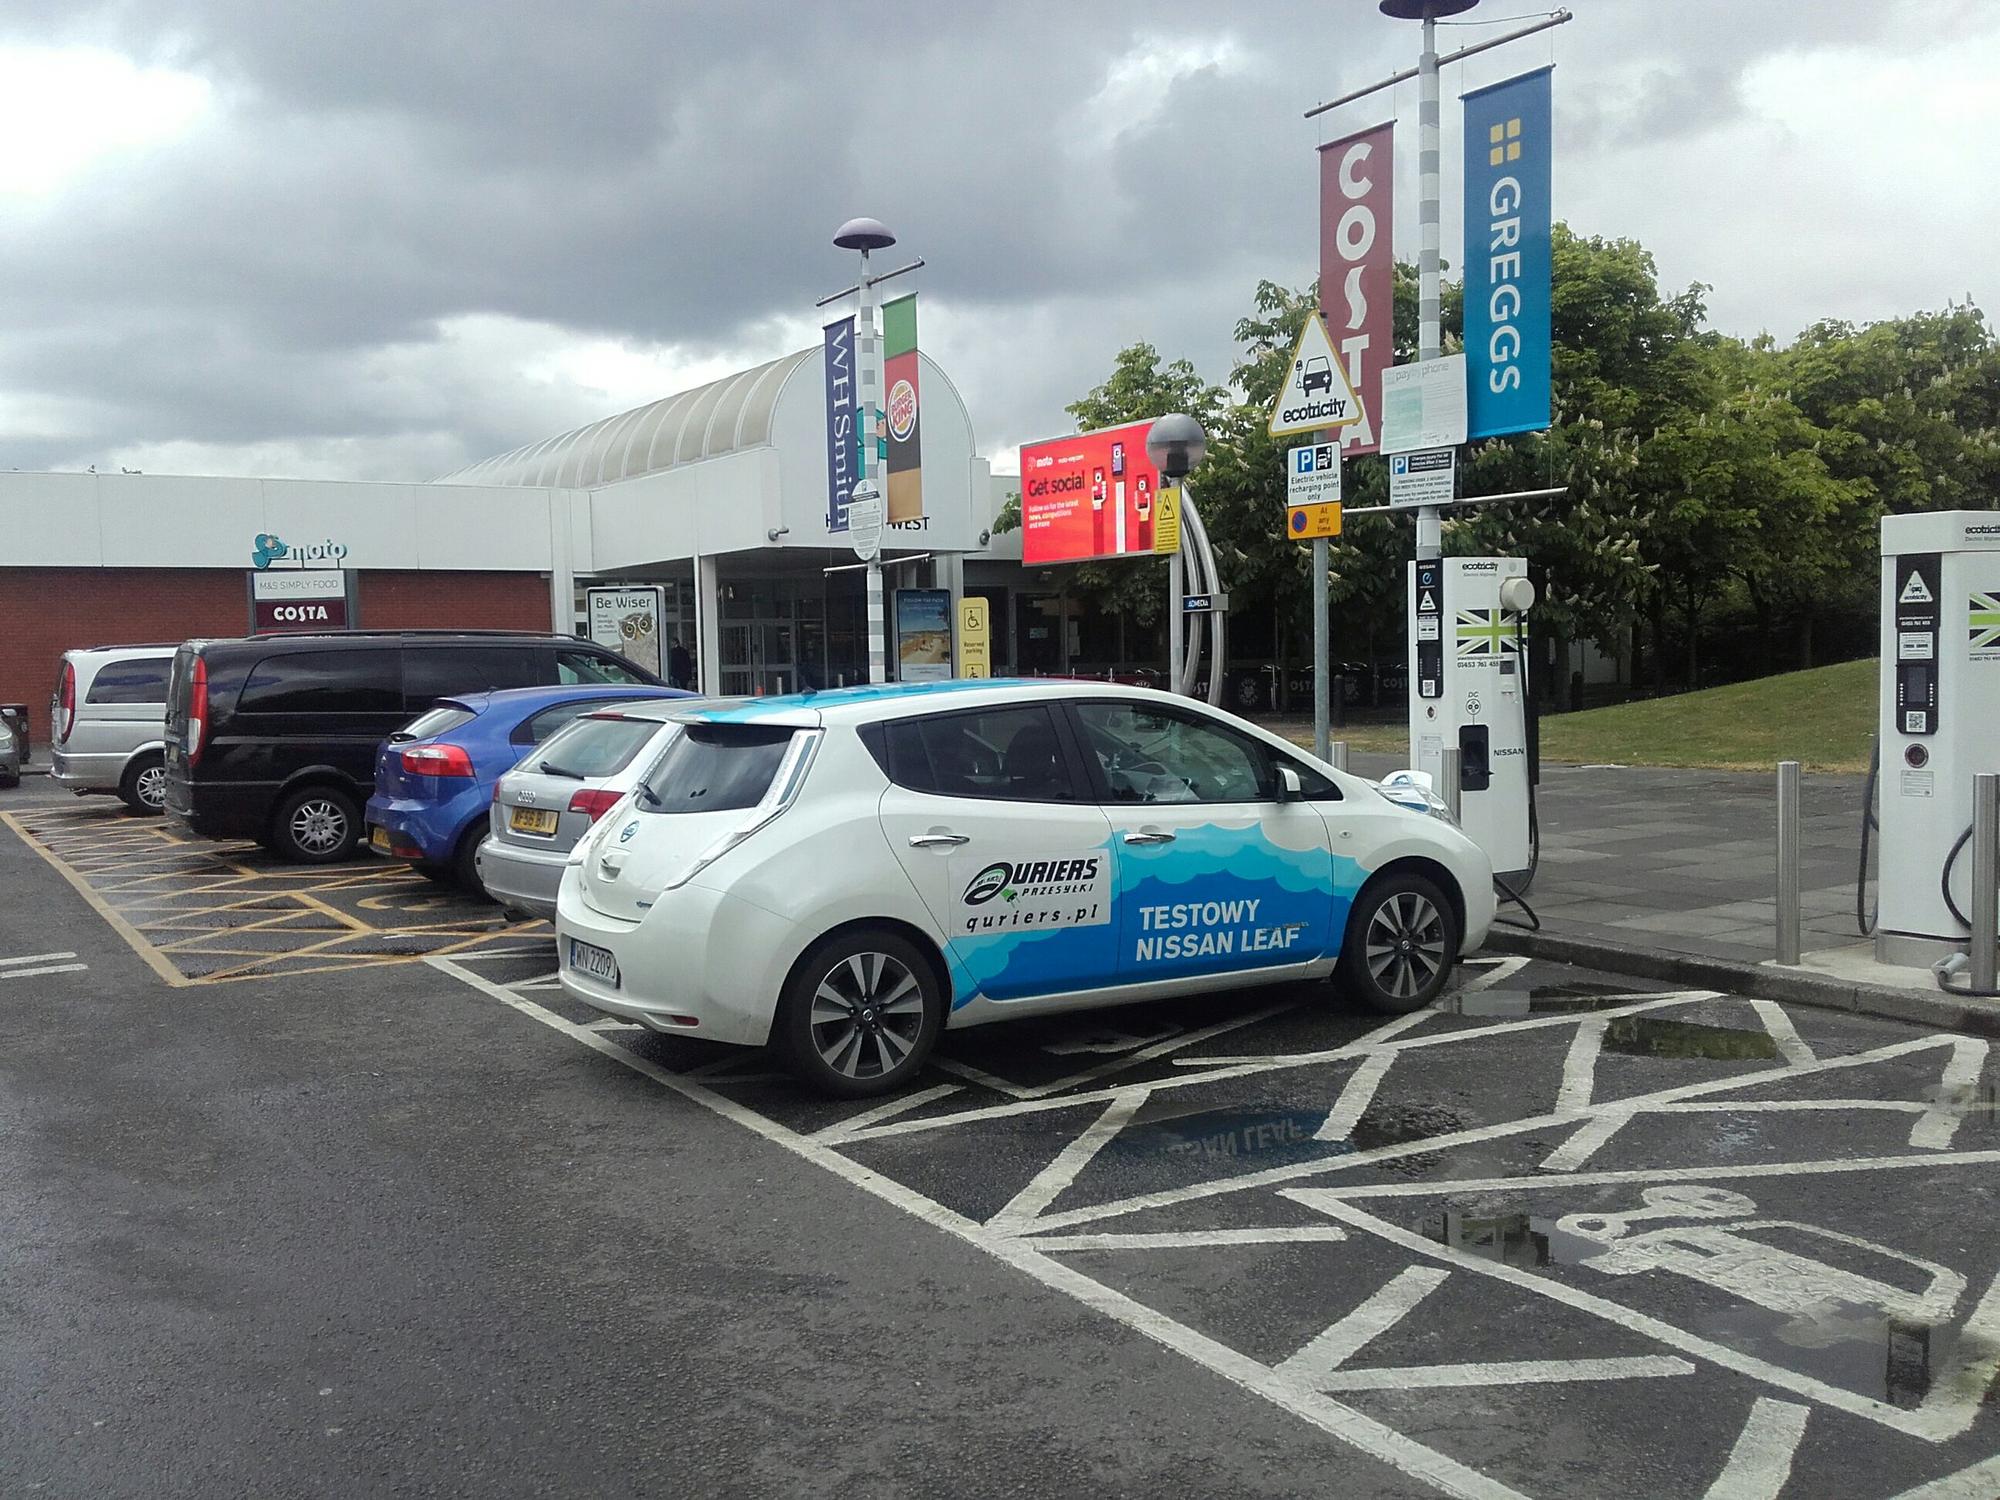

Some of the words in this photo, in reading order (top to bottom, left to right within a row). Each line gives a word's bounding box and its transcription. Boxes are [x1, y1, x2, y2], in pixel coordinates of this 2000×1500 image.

[1488, 175, 1522, 394] GREGGS
[1336, 141, 1376, 450] COSTA
[1283, 398, 1346, 424] ecotricity
[832, 325, 852, 526] WHSmith
[1028, 477, 1049, 497] Get
[1051, 470, 1085, 494] social
[1291, 474, 1315, 485] Electric
[1316, 471, 1338, 482] vehicle
[1289, 483, 1322, 494] recharging
[1323, 481, 1340, 492] point
[1307, 493, 1321, 501] only
[1320, 506, 1328, 514] At
[891, 516, 930, 530] WEST
[1318, 516, 1330, 524] any
[1317, 524, 1331, 533] time
[1462, 562, 1499, 571] ecotricity
[259, 581, 279, 591] M&S
[280, 580, 311, 590] SIMPLY
[312, 579, 338, 589] FOOD
[596, 597, 612, 609] Be
[616, 595, 652, 609] Wiser
[273, 605, 328, 622] COSTA
[965, 647, 983, 655] parking
[1493, 747, 1524, 756] NISSAN
[1022, 883, 1094, 897] PRZESYŁKI
[966, 903, 1098, 933] quriers.pl
[1139, 898, 1261, 931] TESTOWY
[1136, 931, 1234, 962] NISSAN
[1240, 926, 1301, 954] LEAF
